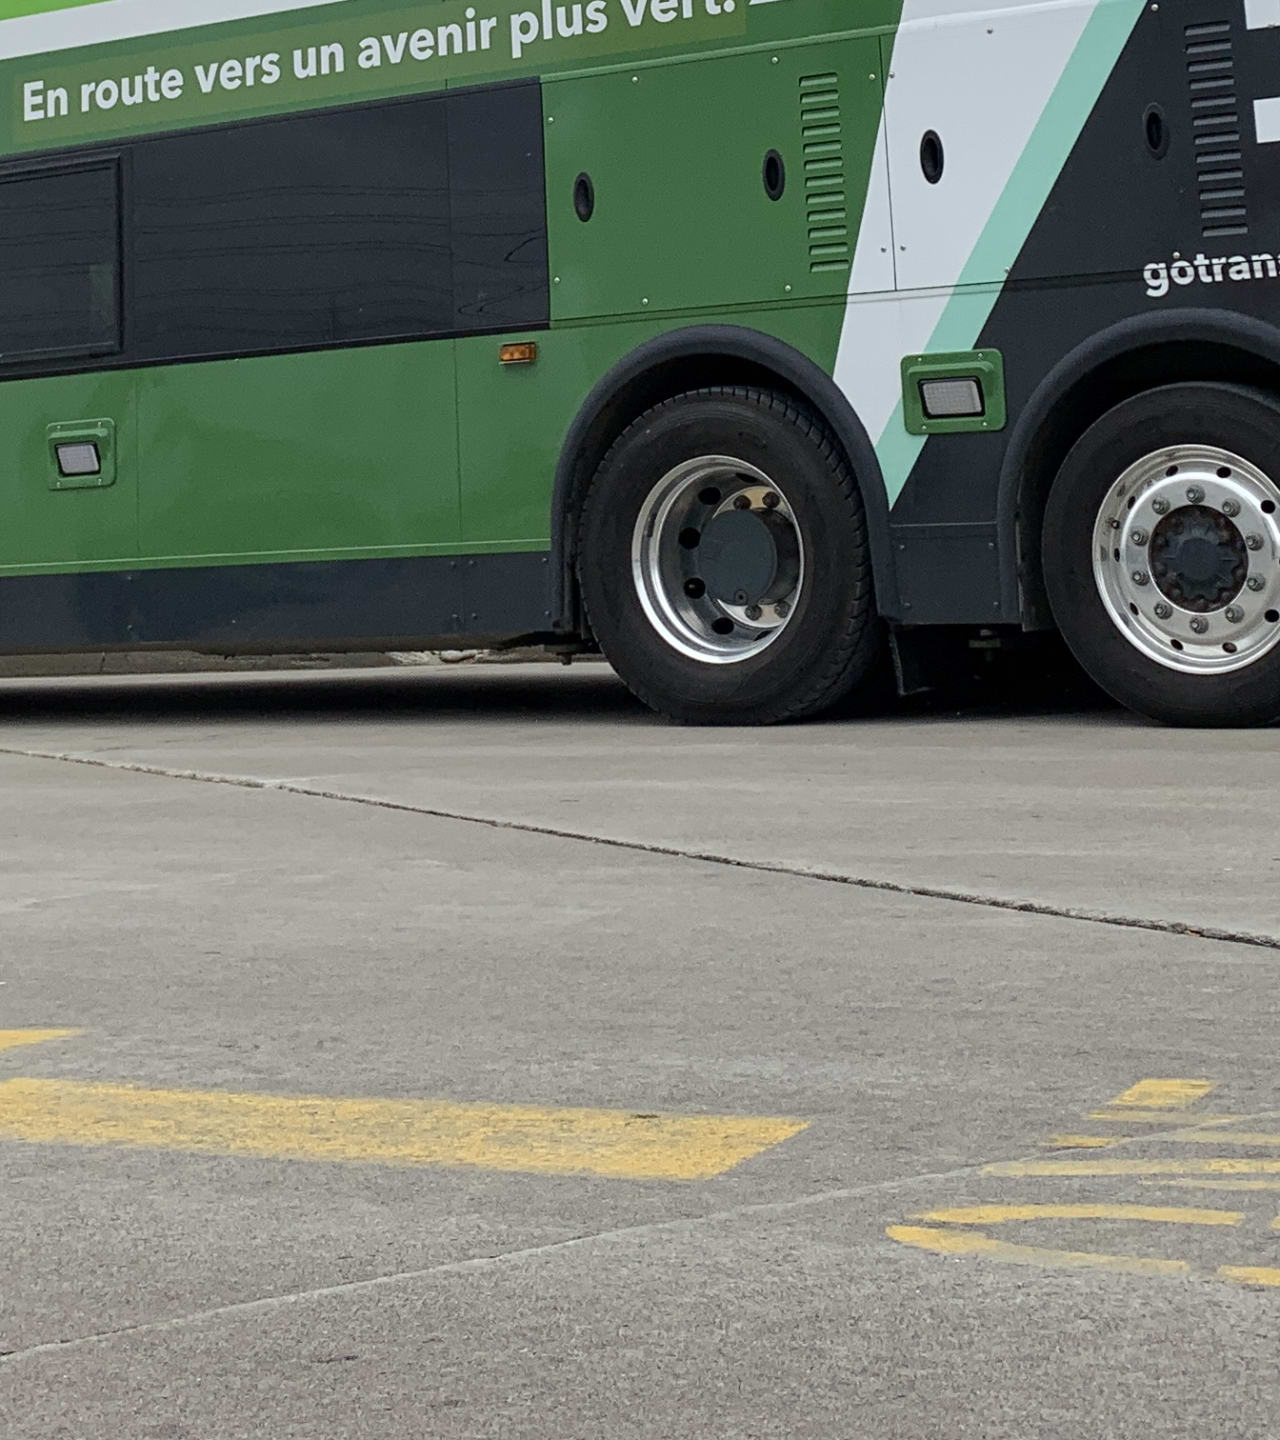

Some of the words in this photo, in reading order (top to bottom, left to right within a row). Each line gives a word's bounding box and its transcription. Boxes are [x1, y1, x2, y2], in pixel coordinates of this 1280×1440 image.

[23, 80, 69, 122] En
[80, 65, 184, 113] route
[193, 52, 281, 94] vers
[292, 42, 345, 79] un
[357, 7, 497, 69] avenir
